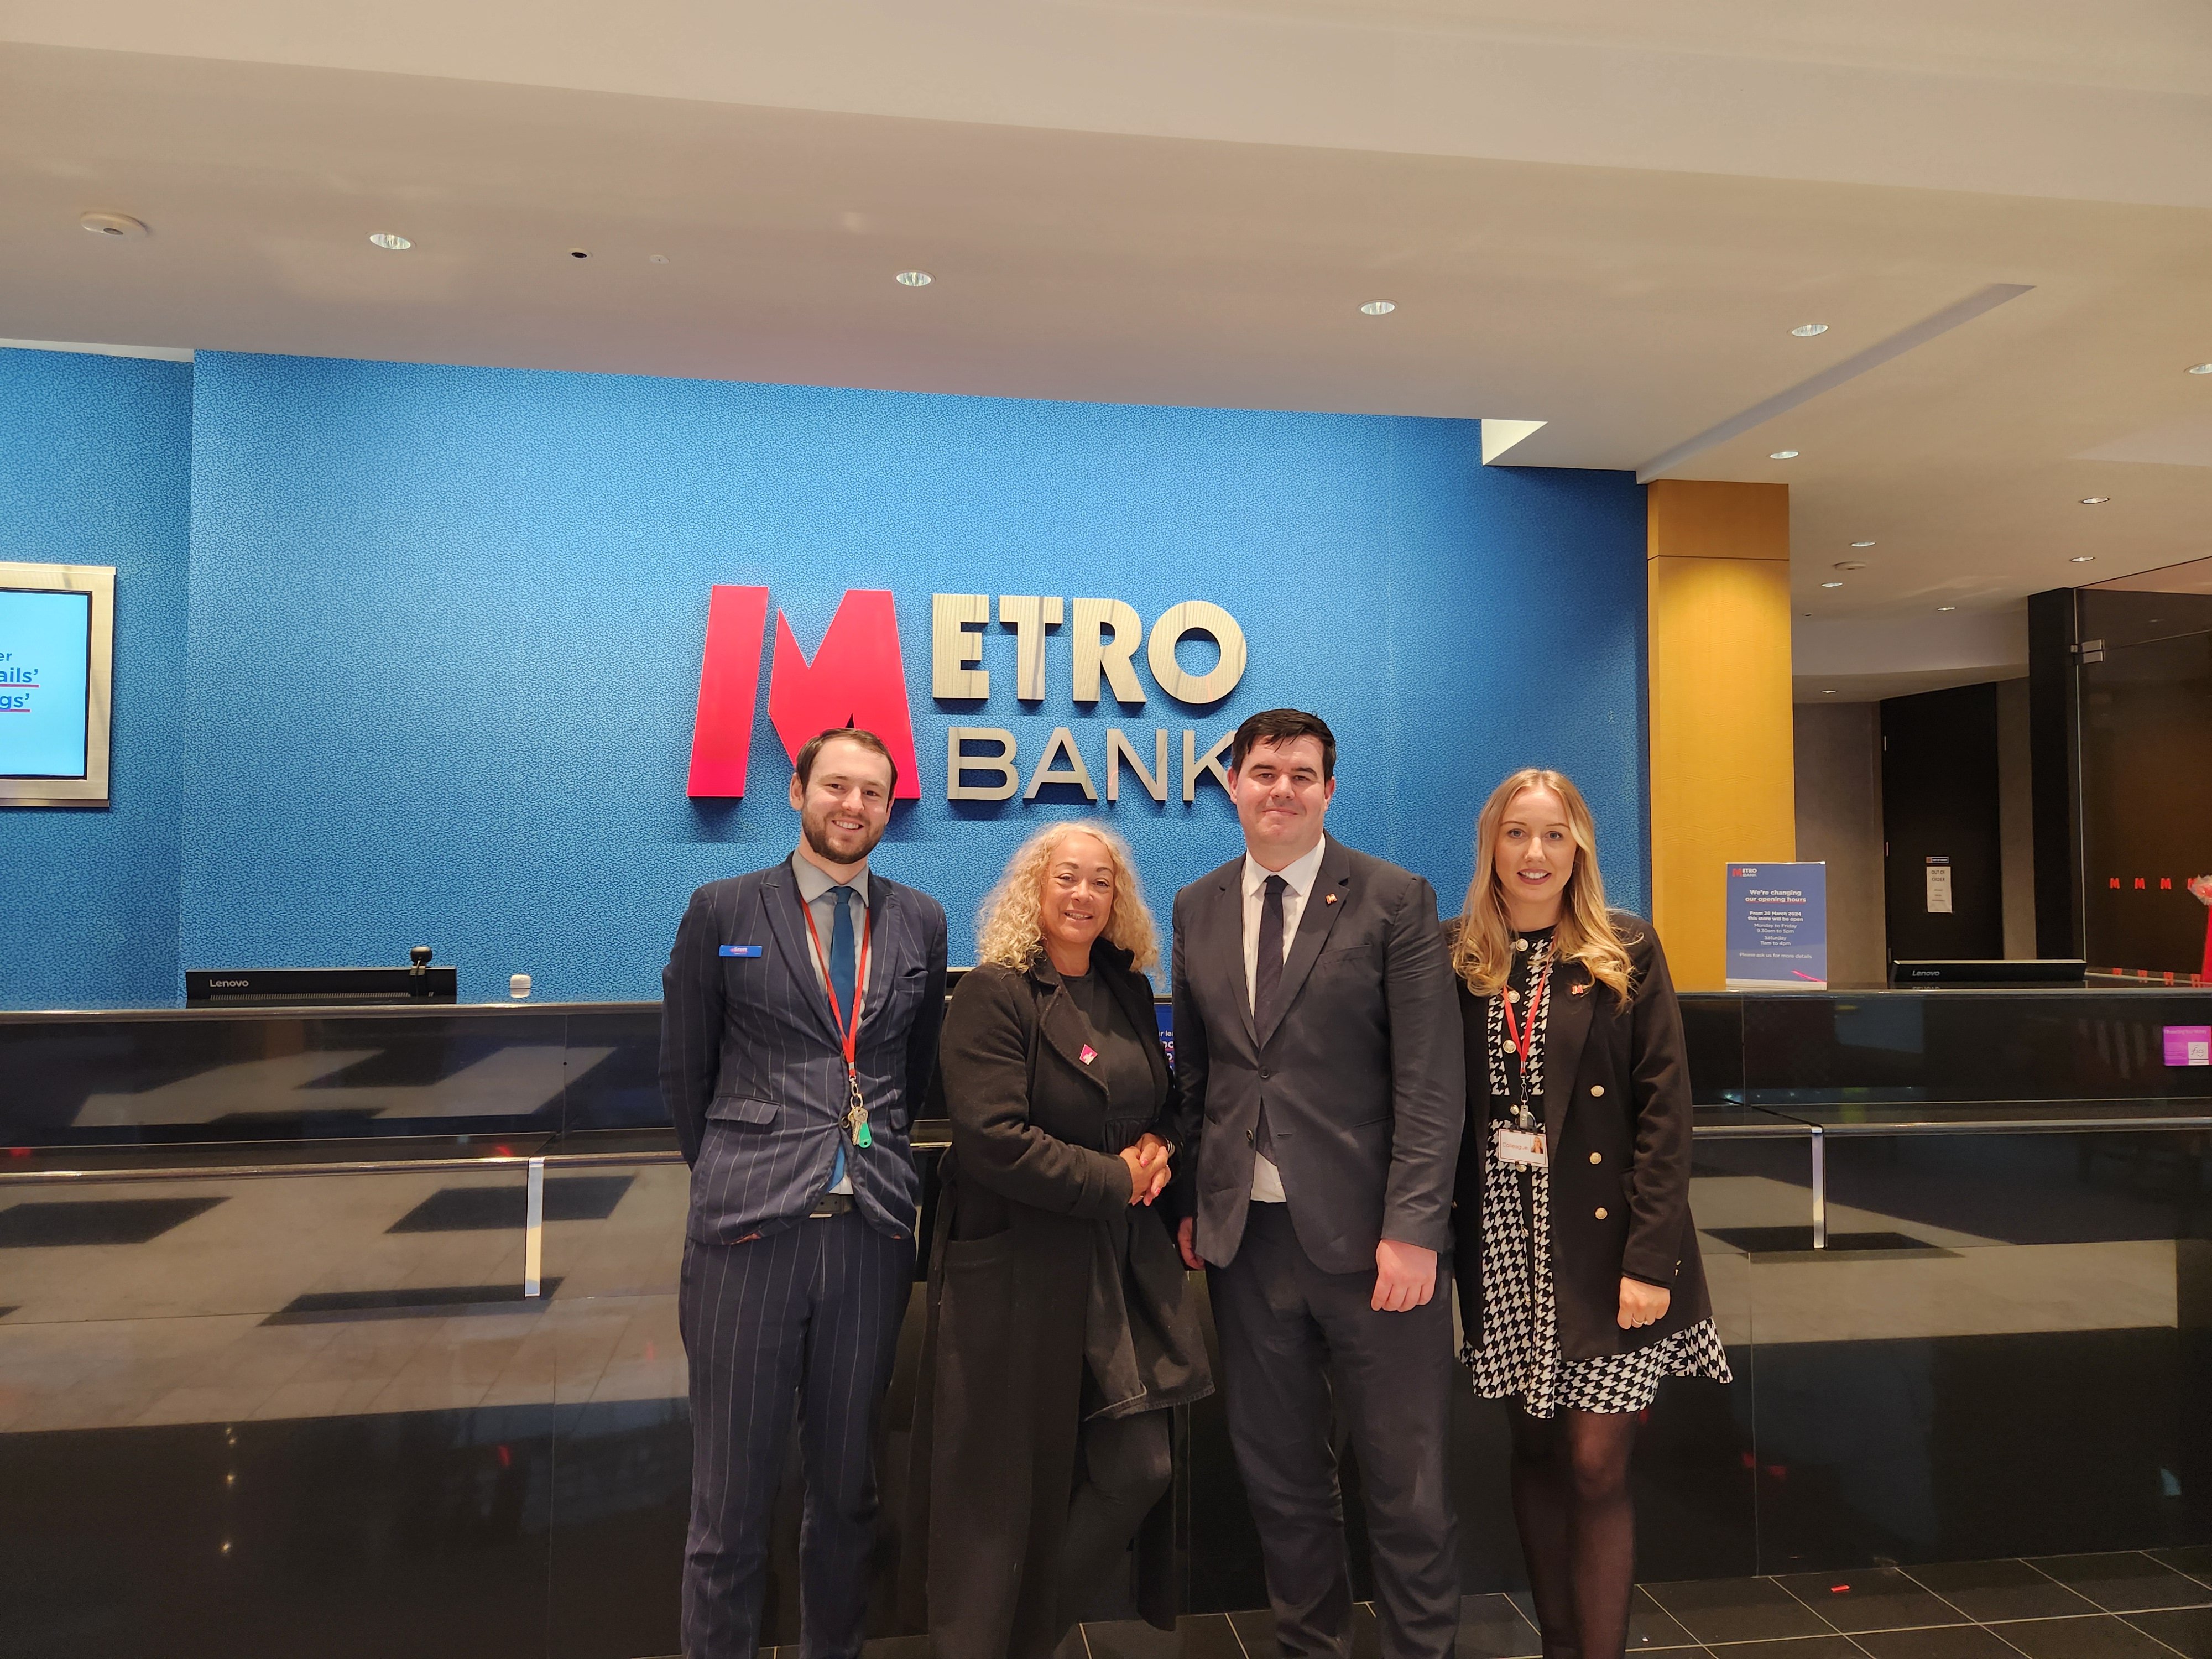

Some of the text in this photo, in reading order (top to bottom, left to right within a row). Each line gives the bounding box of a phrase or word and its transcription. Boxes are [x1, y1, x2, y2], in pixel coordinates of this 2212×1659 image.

[687, 585, 1246, 799] METRO
[947, 726, 1239, 801] BANK
[1503, 1142, 1528, 1150] Colleague
